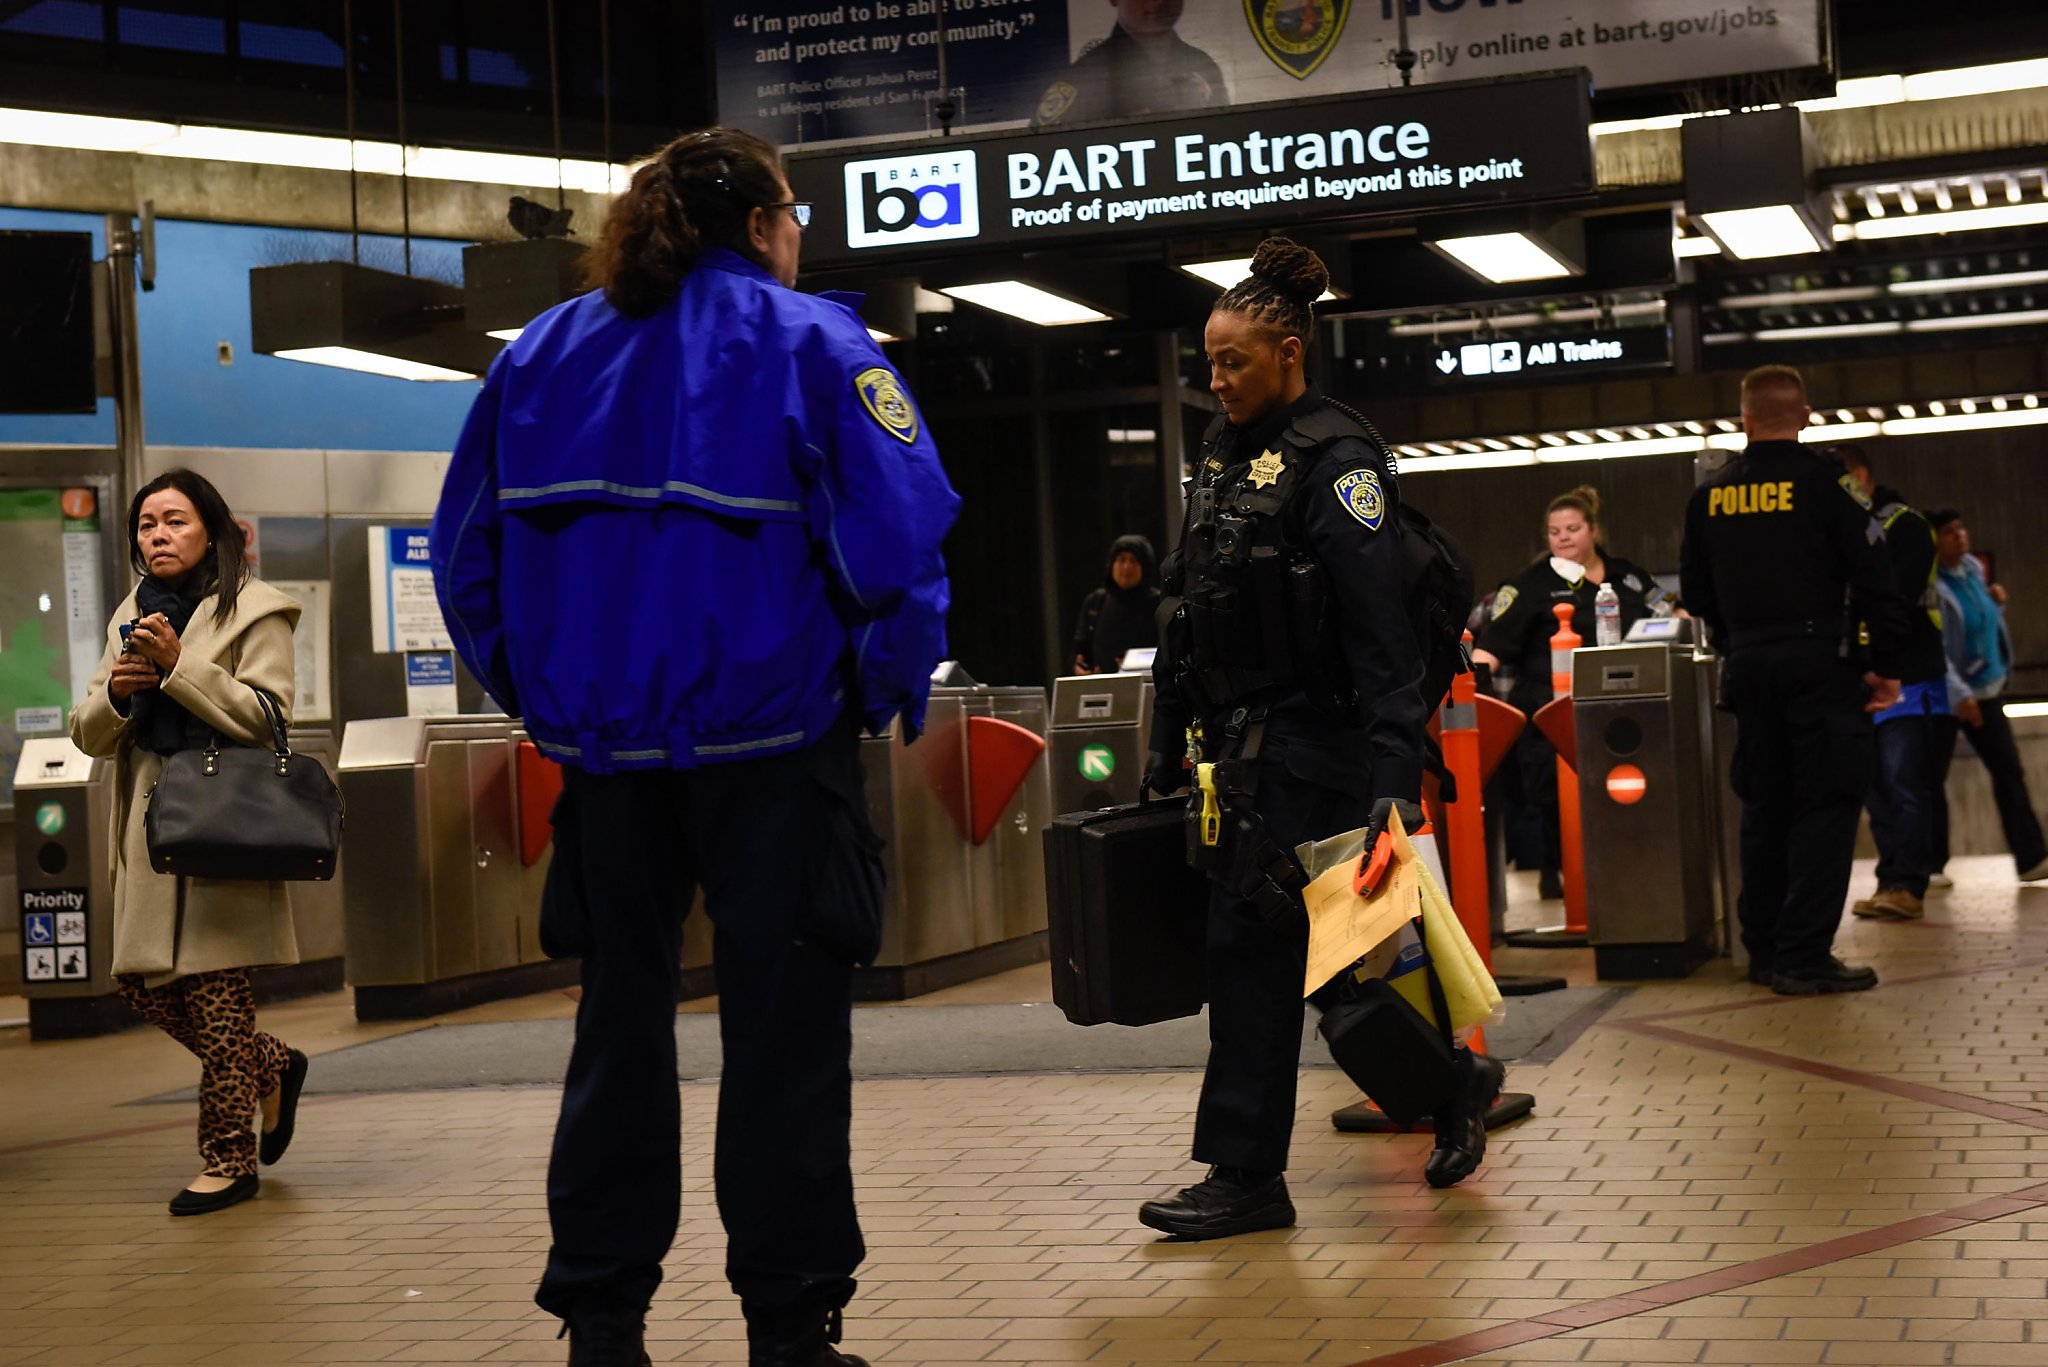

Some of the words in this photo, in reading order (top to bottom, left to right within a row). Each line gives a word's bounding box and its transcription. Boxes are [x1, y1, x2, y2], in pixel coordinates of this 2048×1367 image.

[787, 7, 844, 34] proud
[849, 4, 870, 23] to
[876, 1, 901, 21] be
[755, 42, 790, 63] and
[795, 35, 866, 62] protect
[872, 35, 901, 53] my
[1387, 42, 1459, 69] Aply
[1467, 31, 1550, 59] online
[1559, 27, 1586, 48] at
[1594, 6, 1779, 45] bart.gov/jobs
[756, 83, 786, 99] BART
[788, 79, 823, 96] Police
[825, 75, 863, 91] Officer
[865, 71, 905, 88] Joshua
[906, 67, 939, 83] Perez
[825, 94, 871, 110] resident
[872, 91, 887, 105] of
[888, 89, 909, 104] San
[889, 163, 962, 180] BART
[1007, 139, 1156, 199] BART
[1173, 120, 1431, 183] Entrance
[1011, 204, 1072, 228] Proof
[1076, 201, 1103, 221] of
[1106, 190, 1206, 223] payment
[1211, 178, 1309, 212] required
[1314, 170, 1402, 205] beyond
[1407, 163, 1453, 188] this
[1458, 157, 1523, 187] point
[1526, 341, 1557, 366] All
[1558, 338, 1623, 363] Trains
[1339, 472, 1378, 494] POLICE
[1707, 480, 1795, 518] POLICE
[24, 890, 84, 911] Priority
